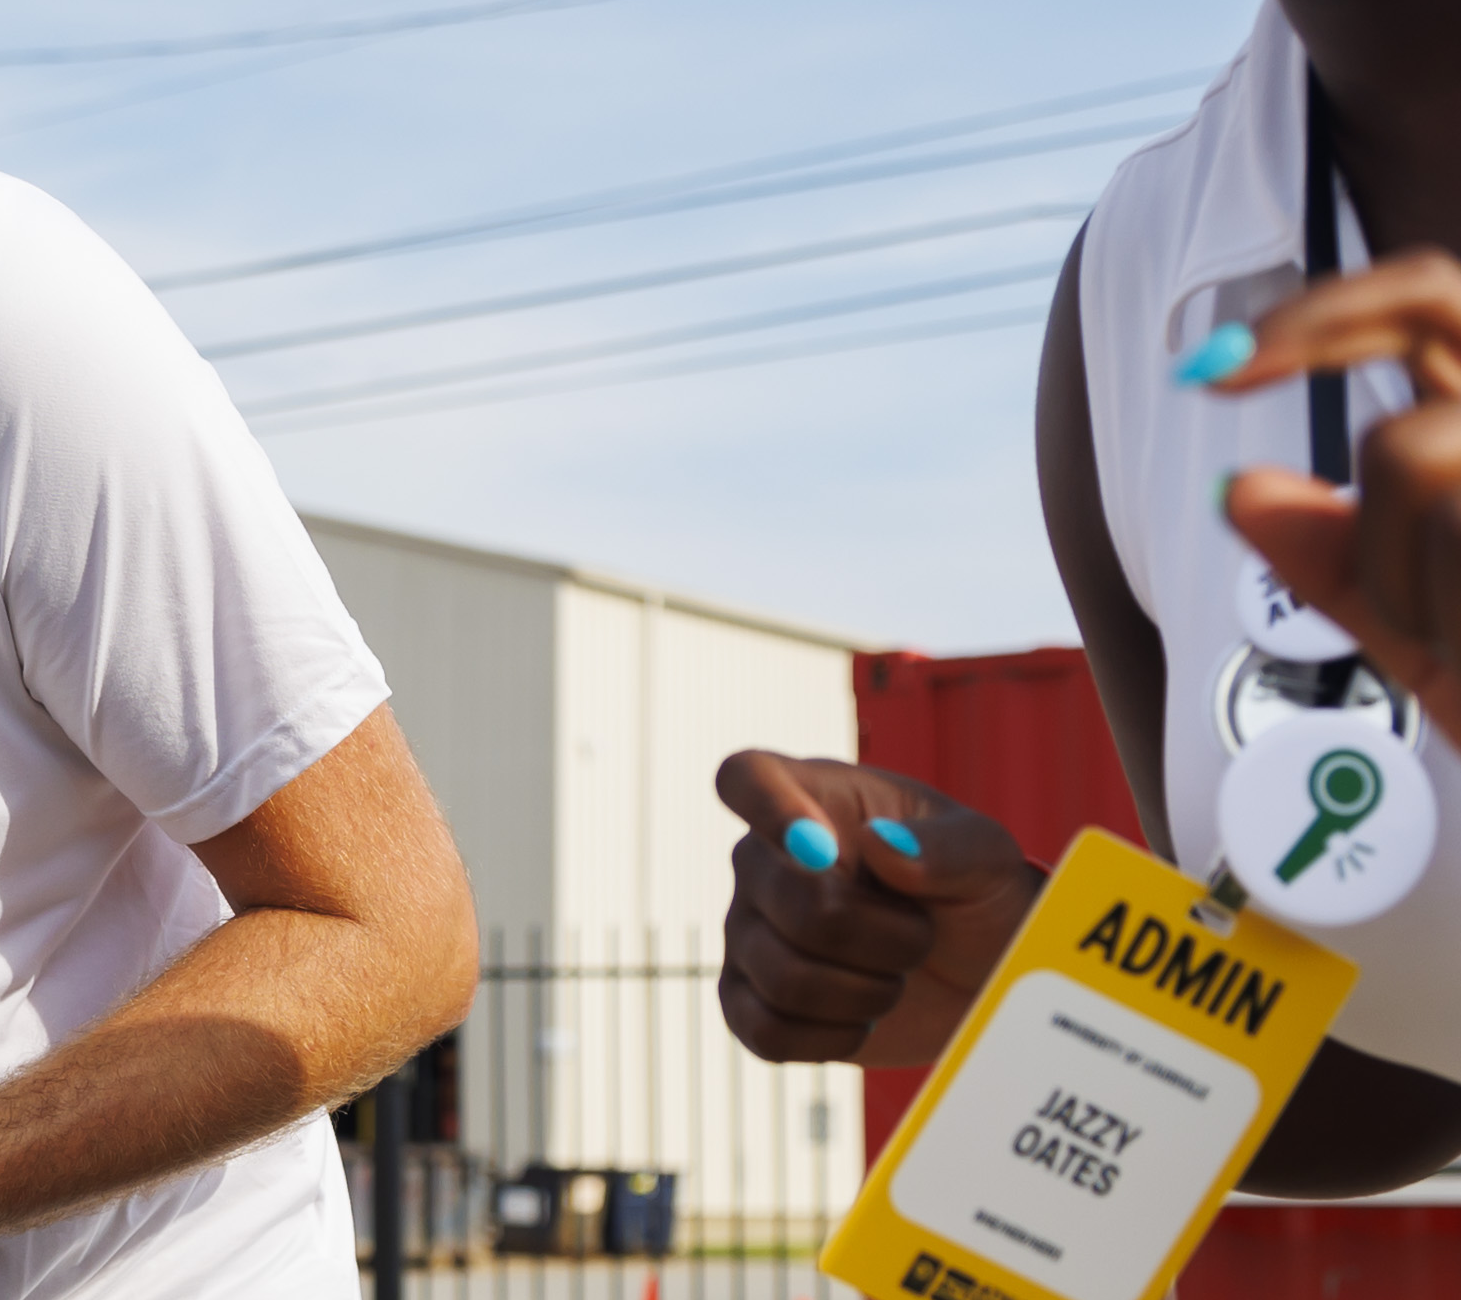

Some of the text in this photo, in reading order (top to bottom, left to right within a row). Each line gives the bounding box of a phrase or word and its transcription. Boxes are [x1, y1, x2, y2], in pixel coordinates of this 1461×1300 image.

[1077, 897, 1286, 1038] ADMIN
[1036, 1087, 1143, 1157] JAZZY
[1012, 1123, 1121, 1196] OATES
